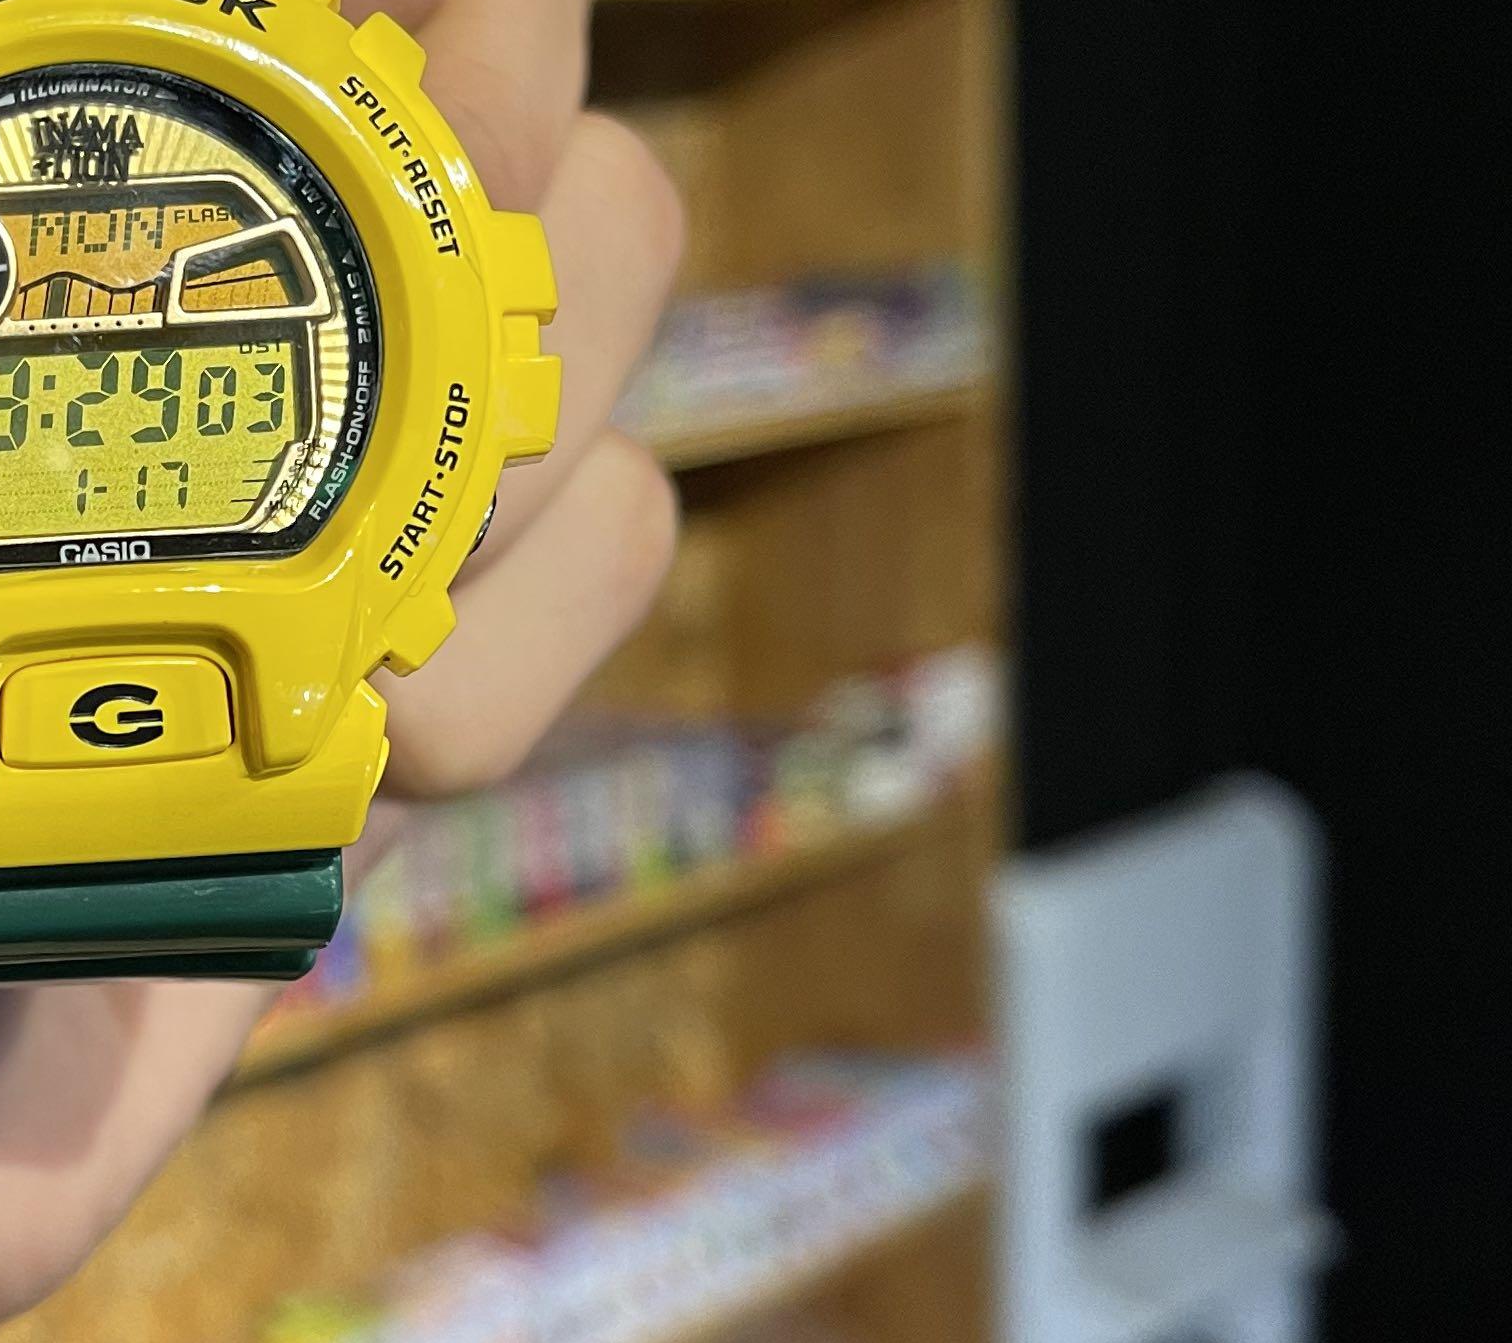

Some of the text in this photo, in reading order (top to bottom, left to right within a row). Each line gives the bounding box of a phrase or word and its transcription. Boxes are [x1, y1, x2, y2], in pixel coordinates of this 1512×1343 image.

[19, 78, 152, 102] ILLUMINATOR
[29, 206, 165, 256] MON
[174, 206, 238, 224] FLAS
[346, 271, 373, 345] STW2
[195, 362, 287, 438] 03
[75, 461, 189, 516] 1-17
[59, 540, 151, 564] CASIO
[68, 683, 164, 748] G
